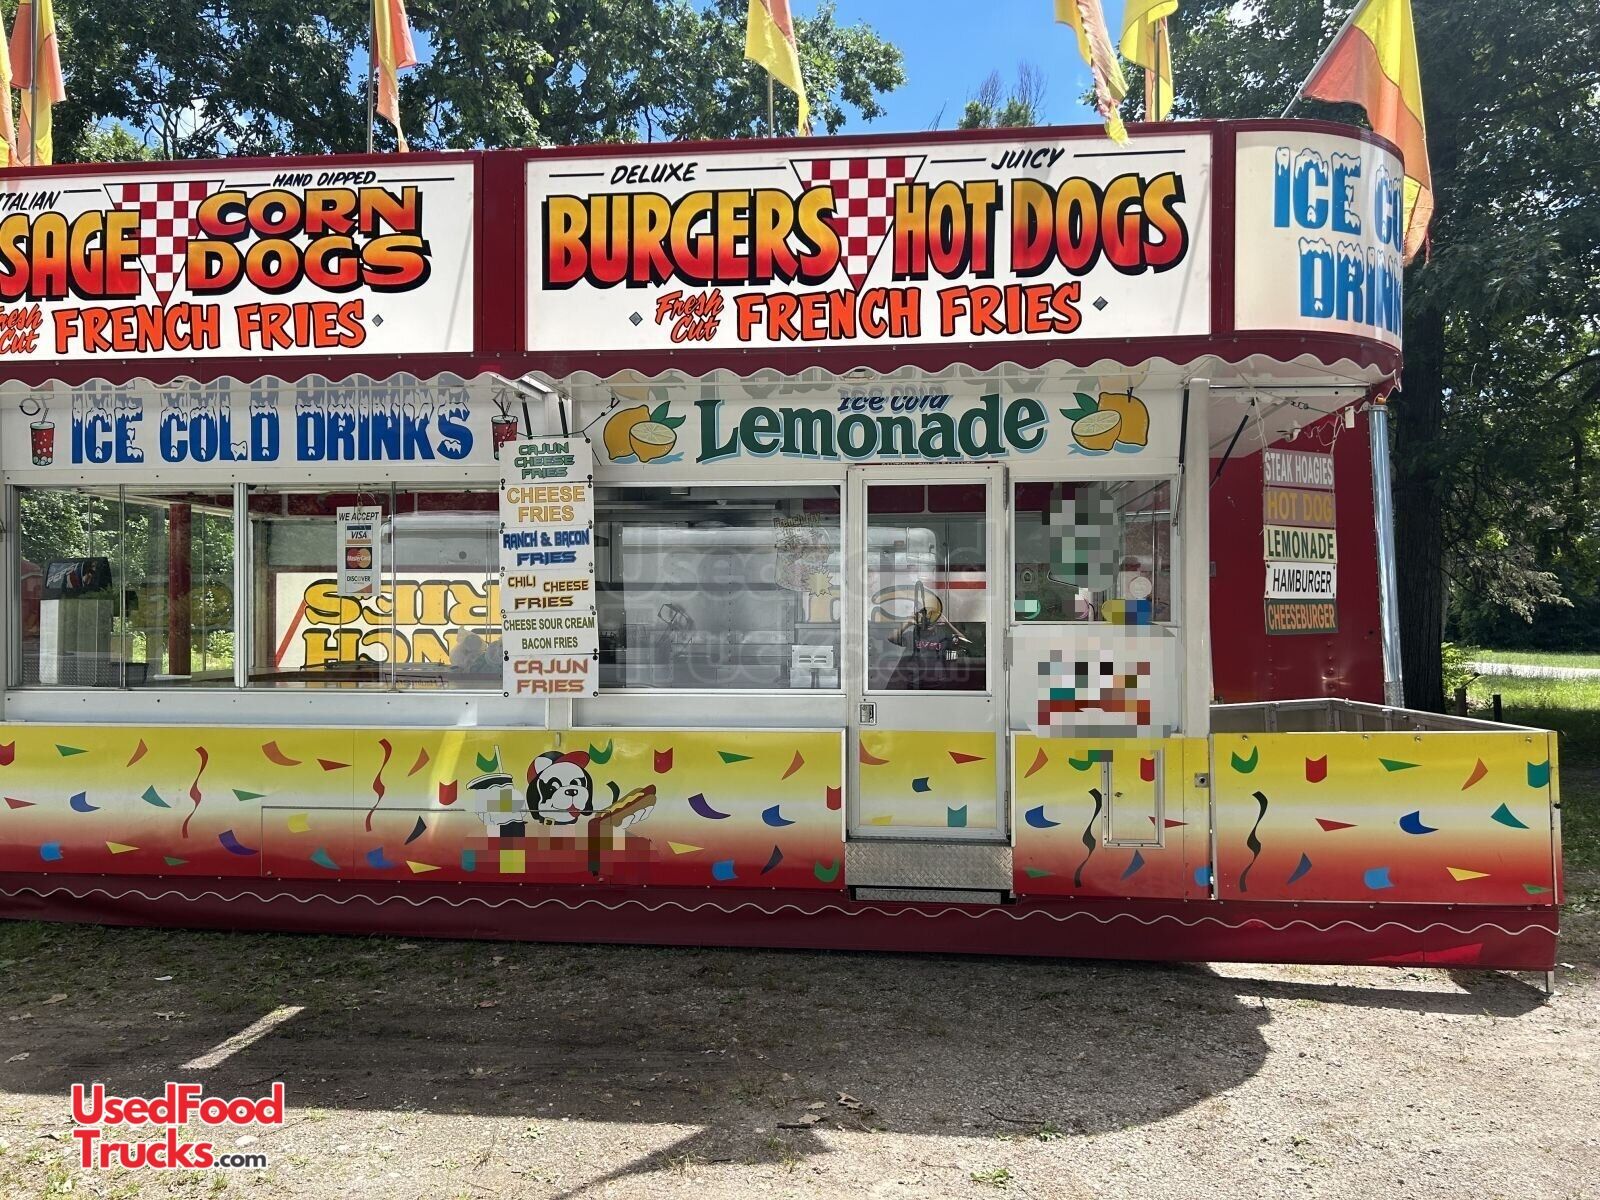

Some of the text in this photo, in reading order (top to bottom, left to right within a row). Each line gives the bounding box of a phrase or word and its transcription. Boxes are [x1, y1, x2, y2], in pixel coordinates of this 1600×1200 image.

[991, 146, 1065, 171] JUICY
[273, 171, 377, 188] HAND DIPPED
[610, 162, 698, 184] DELUXE
[1273, 146, 1362, 236] ICE
[195, 186, 424, 240] CORN
[543, 184, 842, 291] BURGERS
[892, 172, 1189, 282] HOT DOGS
[187, 234, 433, 295] DOGS
[654, 288, 725, 324] Fresh
[736, 281, 1082, 341] FRENCH FRIES
[52, 299, 367, 354] FRENCH FRIES
[670, 313, 719, 344] Cut
[0, 327, 40, 355] Cut
[71, 402, 474, 464] ICE COLD DRINKS
[697, 392, 1048, 462] Lemonade
[513, 454, 576, 468] CHEESE
[518, 441, 570, 456] CAJUN
[521, 467, 568, 480] FRIES
[1264, 451, 1334, 486] STEAK HOAGIES
[506, 485, 586, 504] CHEESE
[1267, 491, 1333, 523] HOT DOG
[339, 511, 380, 521] WE ACCEPT
[518, 505, 575, 523] FRIES
[351, 530, 368, 540] VISA
[503, 528, 590, 550] RANCH & BACON
[1267, 529, 1335, 560] LEMONADE
[516, 550, 577, 566] FRIES
[507, 575, 590, 593] CHILI CHEESE
[1272, 568, 1333, 594] HAMBURGER
[303, 579, 500, 626] RIES
[514, 595, 574, 610] FRIES
[503, 616, 595, 631] CHEESE SOUR CREAM
[1267, 603, 1337, 631] CHEESEBURGER
[521, 636, 578, 650] BACON FRIES
[513, 658, 589, 676] CAJUN
[516, 679, 585, 695] FRIES
